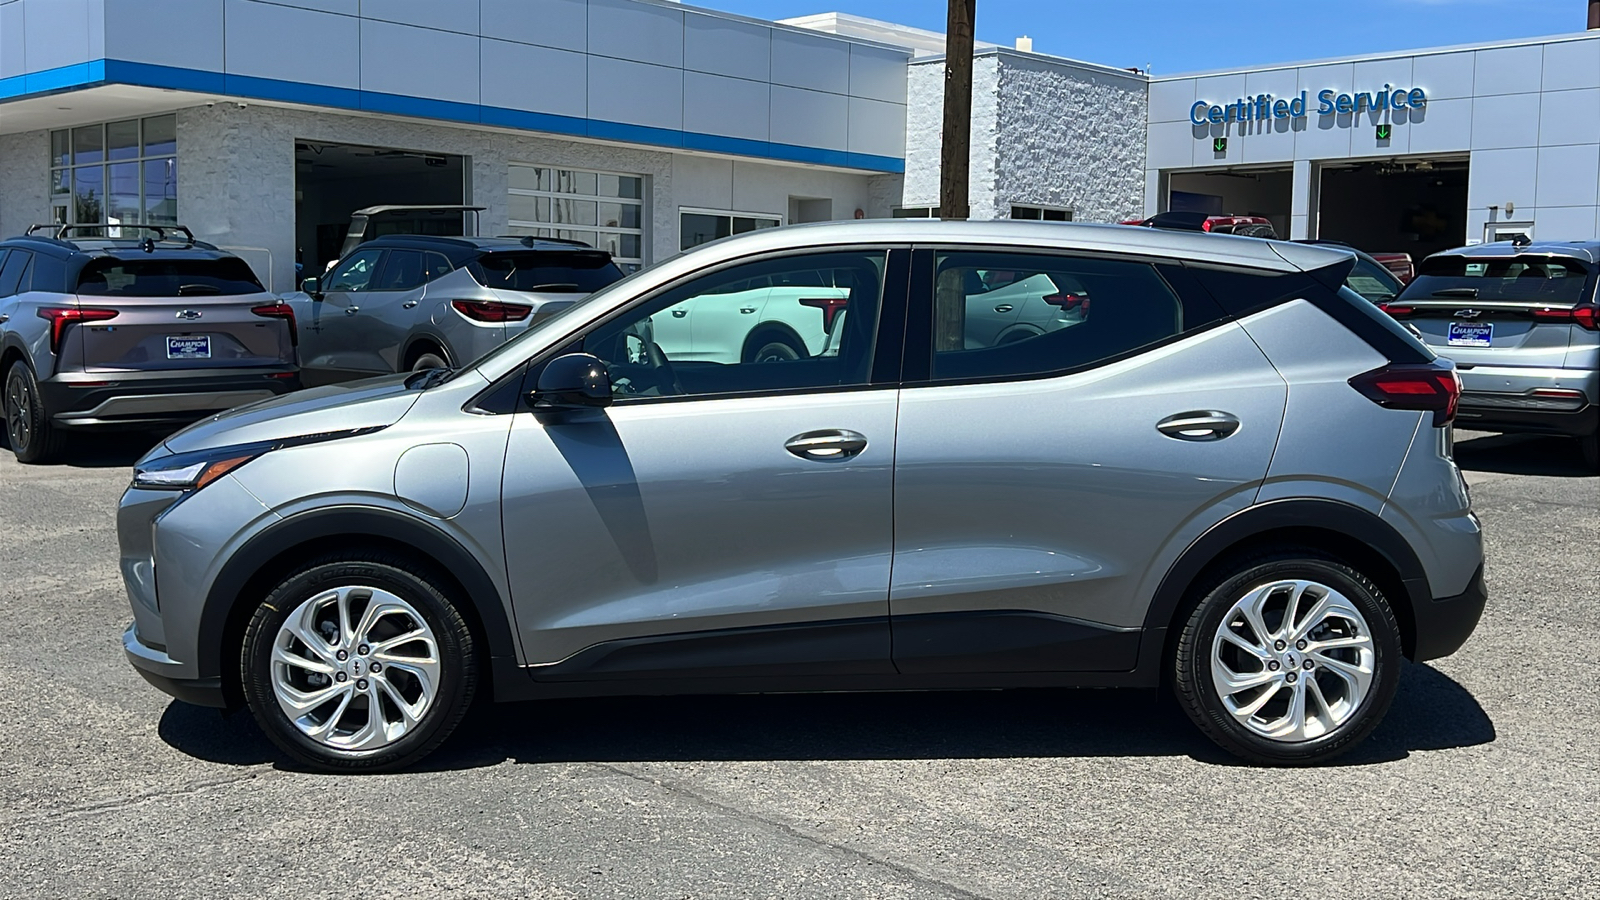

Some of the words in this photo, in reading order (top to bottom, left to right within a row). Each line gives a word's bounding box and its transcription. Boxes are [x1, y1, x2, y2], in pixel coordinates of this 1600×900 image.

[1190, 90, 1307, 126] Certified
[1317, 83, 1426, 115] Service
[1452, 326, 1489, 334] CHAMPION
[170, 340, 207, 348] CHAMPION
